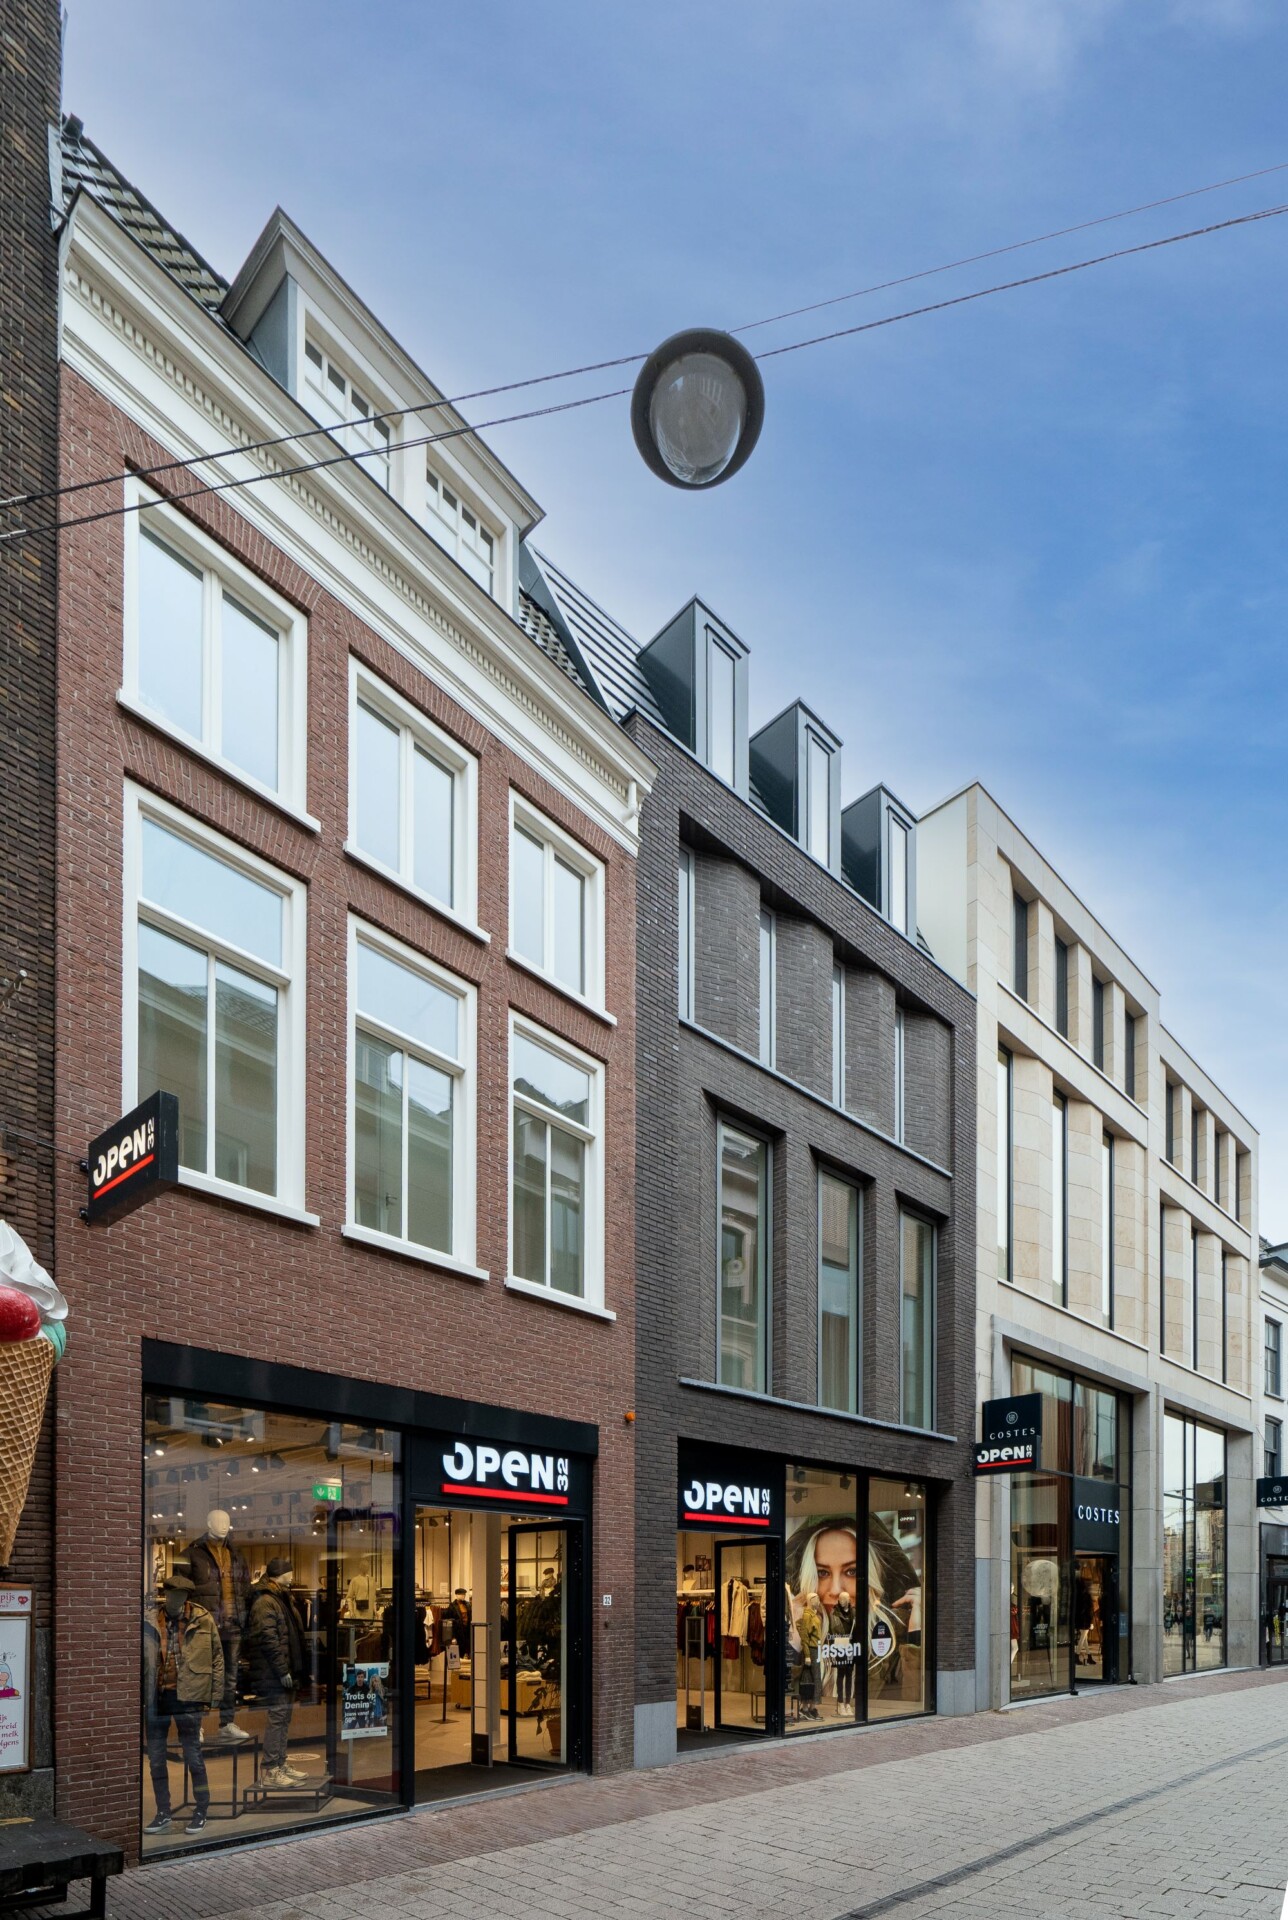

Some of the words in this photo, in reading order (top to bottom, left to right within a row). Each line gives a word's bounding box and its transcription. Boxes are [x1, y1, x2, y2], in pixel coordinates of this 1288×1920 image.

[147, 1117, 155, 1150] 32
[989, 1427, 1036, 1440] COSTES
[1025, 1444, 1033, 1458] 32
[557, 1457, 569, 1492] 32
[761, 1488, 770, 1516] 32
[1260, 1495, 1288, 1503] COSTE
[1078, 1504, 1120, 1524] COSTES
[816, 1640, 861, 1663] jassen
[345, 1692, 365, 1700] Trots
[366, 1692, 376, 1700] op
[344, 1701, 369, 1710] Denim
[0, 1721, 17, 1730] reid
[2, 1730, 19, 1738] melk
[0, 1740, 19, 1749] lgens
